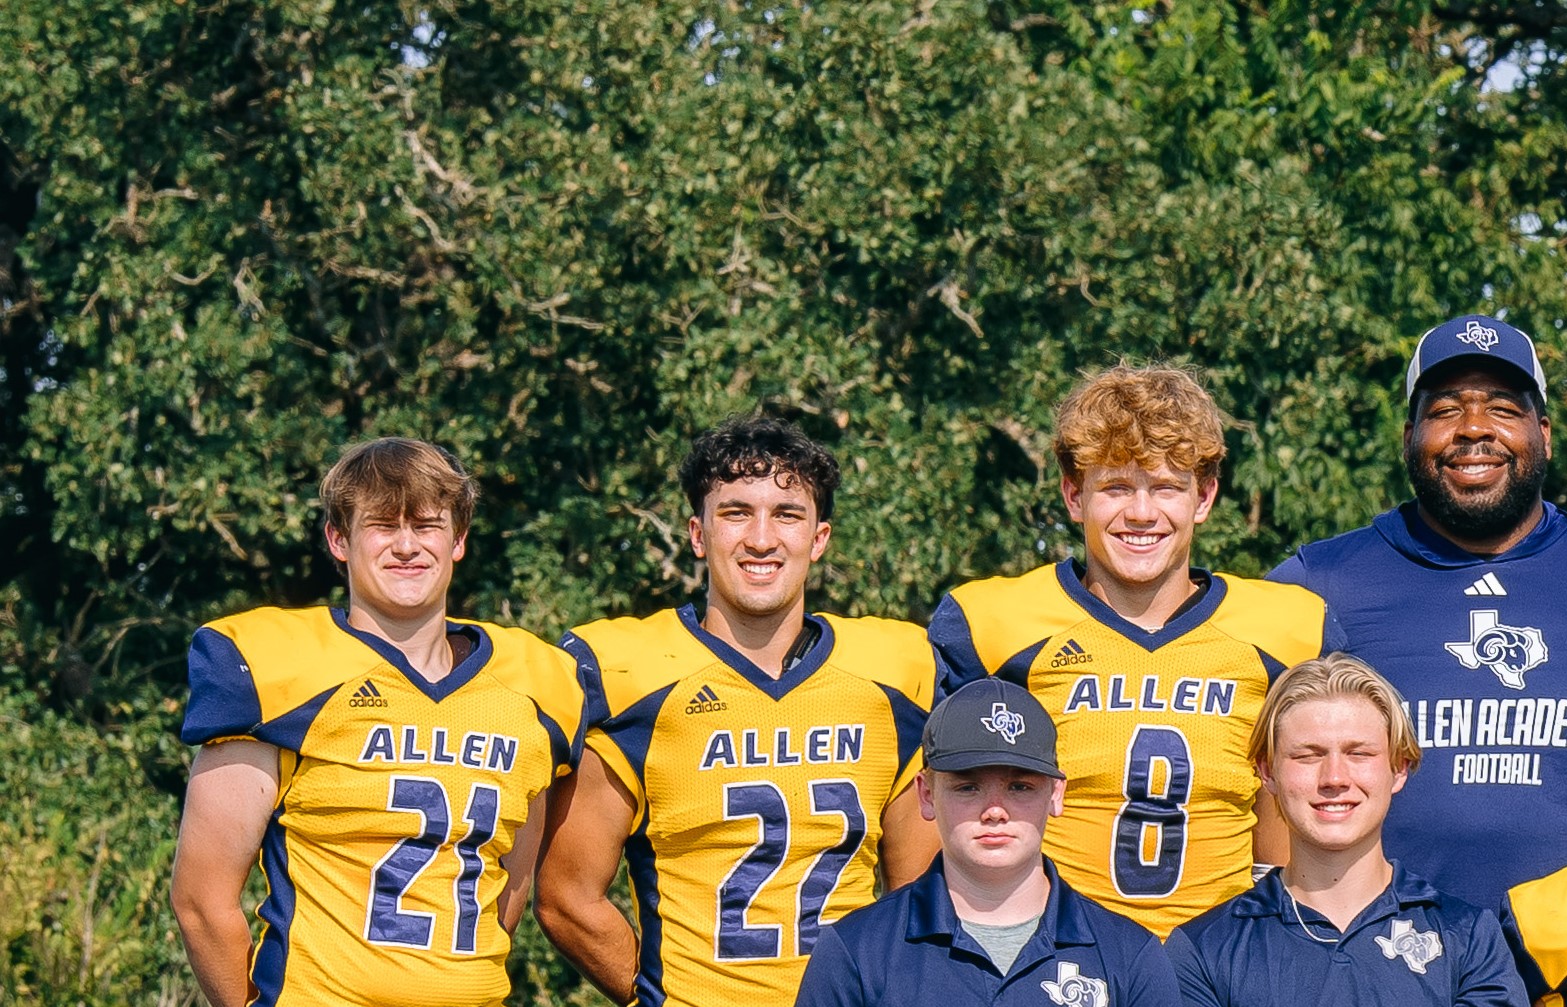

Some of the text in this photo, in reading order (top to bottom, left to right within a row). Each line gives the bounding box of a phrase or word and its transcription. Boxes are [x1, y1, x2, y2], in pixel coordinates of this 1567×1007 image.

[1051, 654, 1092, 668] adidas
[349, 697, 388, 708] adidas
[685, 701, 727, 715] adidas
[1063, 674, 1236, 717] ALLEN
[357, 723, 519, 774] ALLEN
[698, 723, 866, 771] ALLEN
[1452, 753, 1542, 786] FOOTBALL
[1110, 724, 1195, 898] 8
[363, 775, 500, 955] 21
[713, 779, 869, 963] 22
